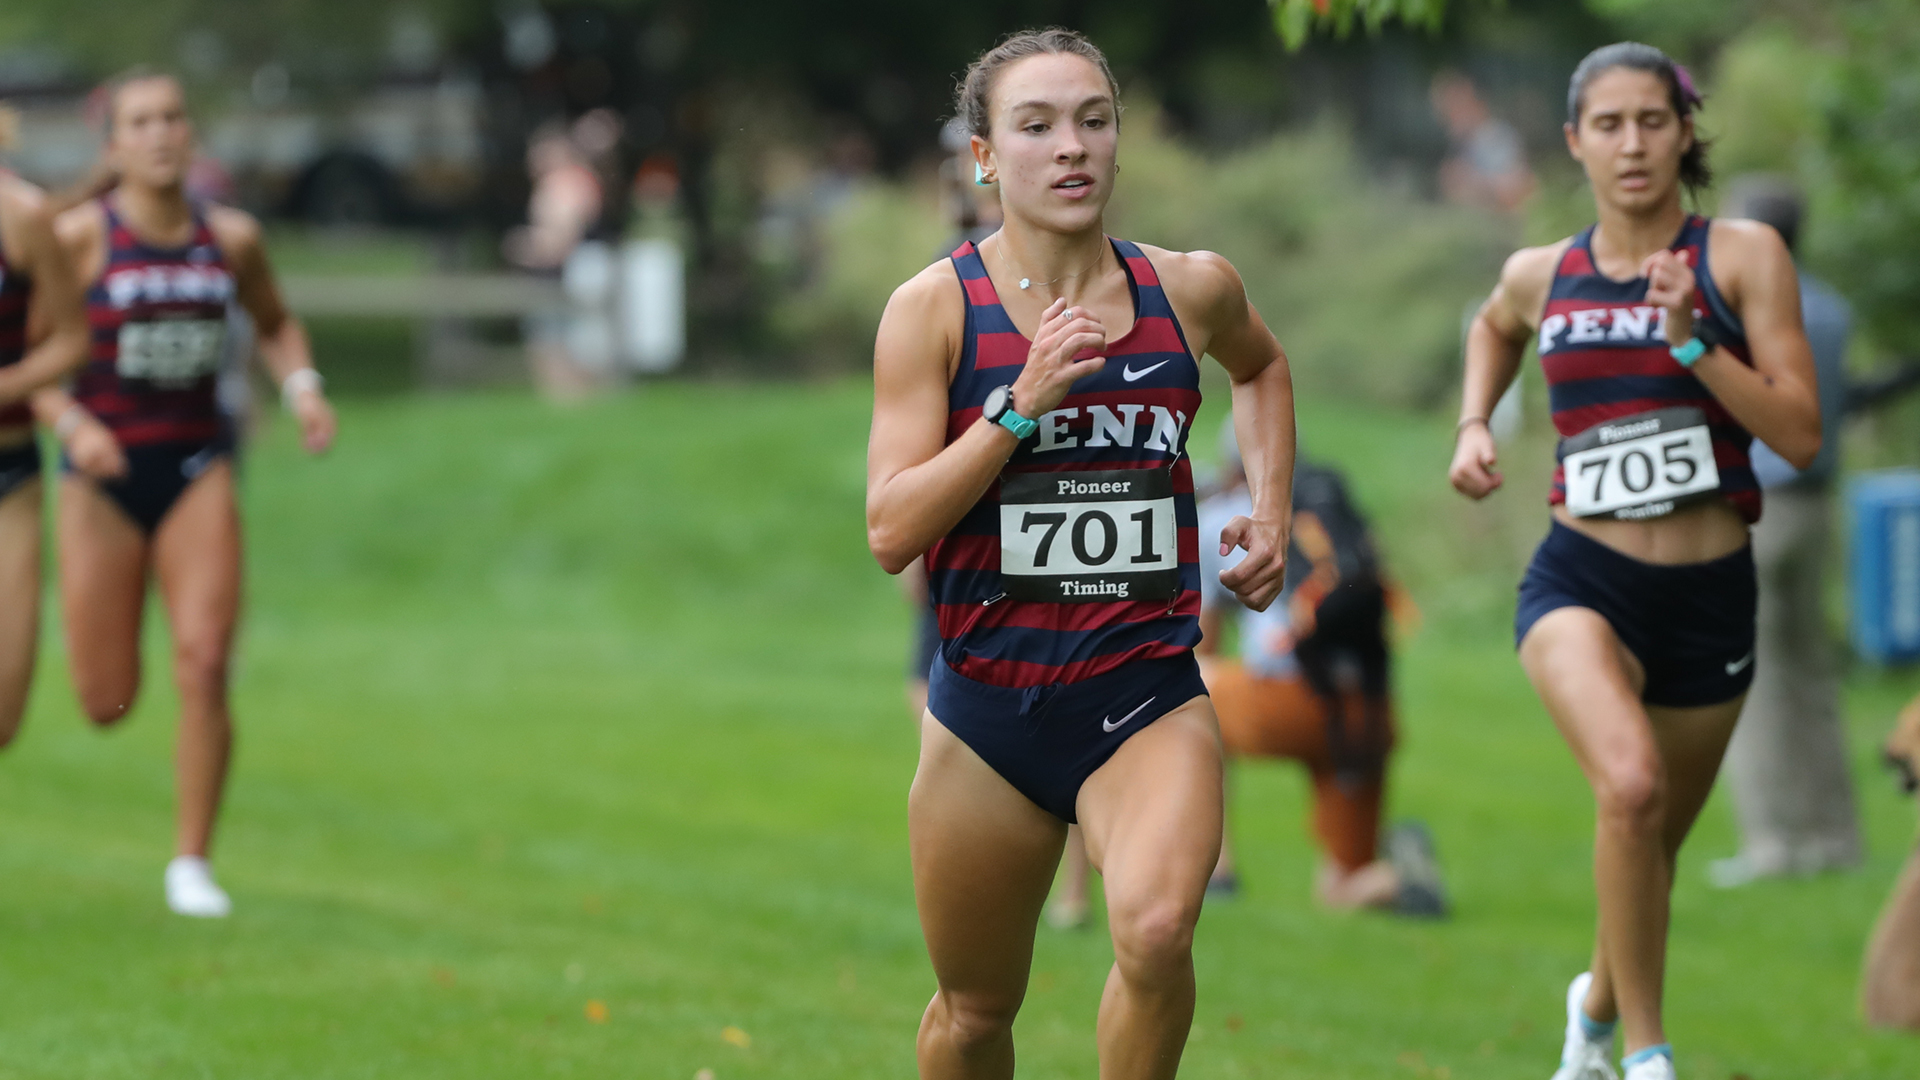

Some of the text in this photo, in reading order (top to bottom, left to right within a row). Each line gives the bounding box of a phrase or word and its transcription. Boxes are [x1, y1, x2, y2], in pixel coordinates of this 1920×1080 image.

[1538, 305, 1703, 353] PEN
[1031, 403, 1187, 455] ENN
[1057, 480, 1131, 495] Pioneer
[1579, 440, 1697, 502] 705
[1020, 508, 1162, 567] 701
[1060, 580, 1129, 597] Timing
